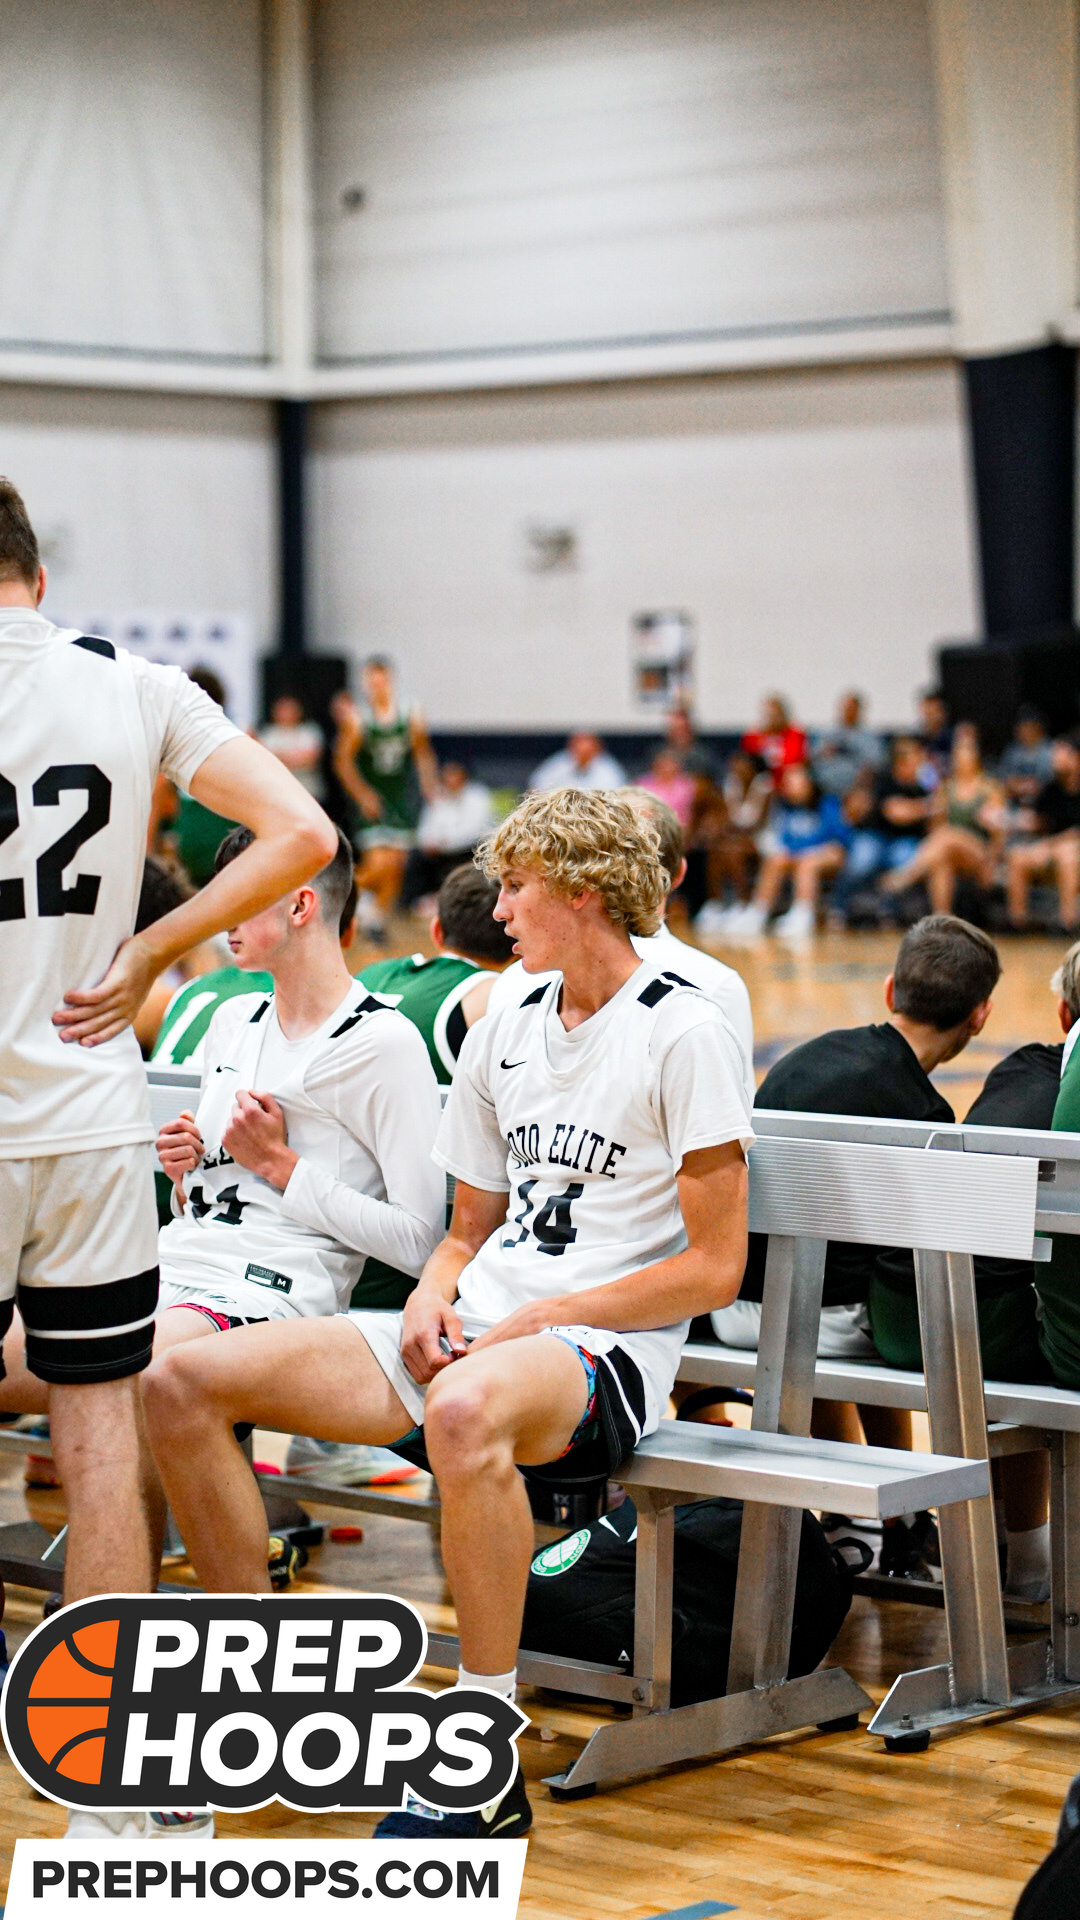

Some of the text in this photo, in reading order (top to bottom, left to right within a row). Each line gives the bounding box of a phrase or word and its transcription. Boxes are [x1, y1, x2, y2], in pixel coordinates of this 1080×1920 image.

[548, 1123, 627, 1179] ELITE
[502, 1179, 584, 1257] 14
[277, 1278, 287, 1287] M
